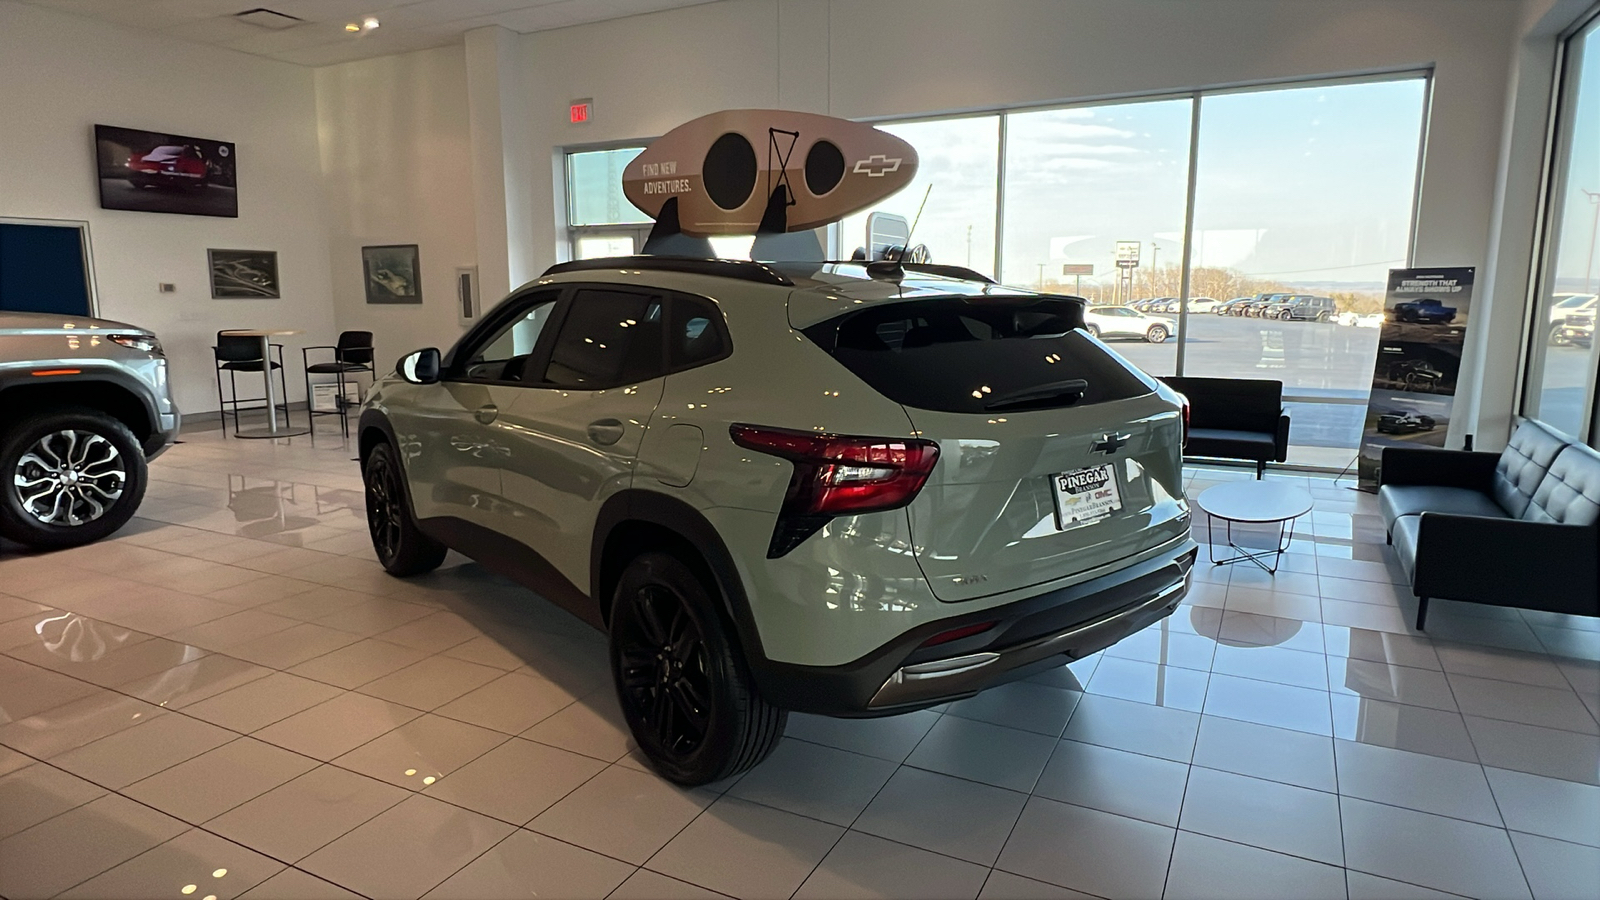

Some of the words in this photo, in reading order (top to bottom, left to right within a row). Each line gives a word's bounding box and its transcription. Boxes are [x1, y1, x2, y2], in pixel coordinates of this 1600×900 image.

[643, 163, 659, 176] FIND
[660, 161, 677, 175] NEW
[643, 179, 692, 194] ADVENTURES.
[1060, 469, 1108, 490] PINEGAR
[1075, 483, 1100, 494] BRANSON
[1095, 489, 1112, 499] GMC
